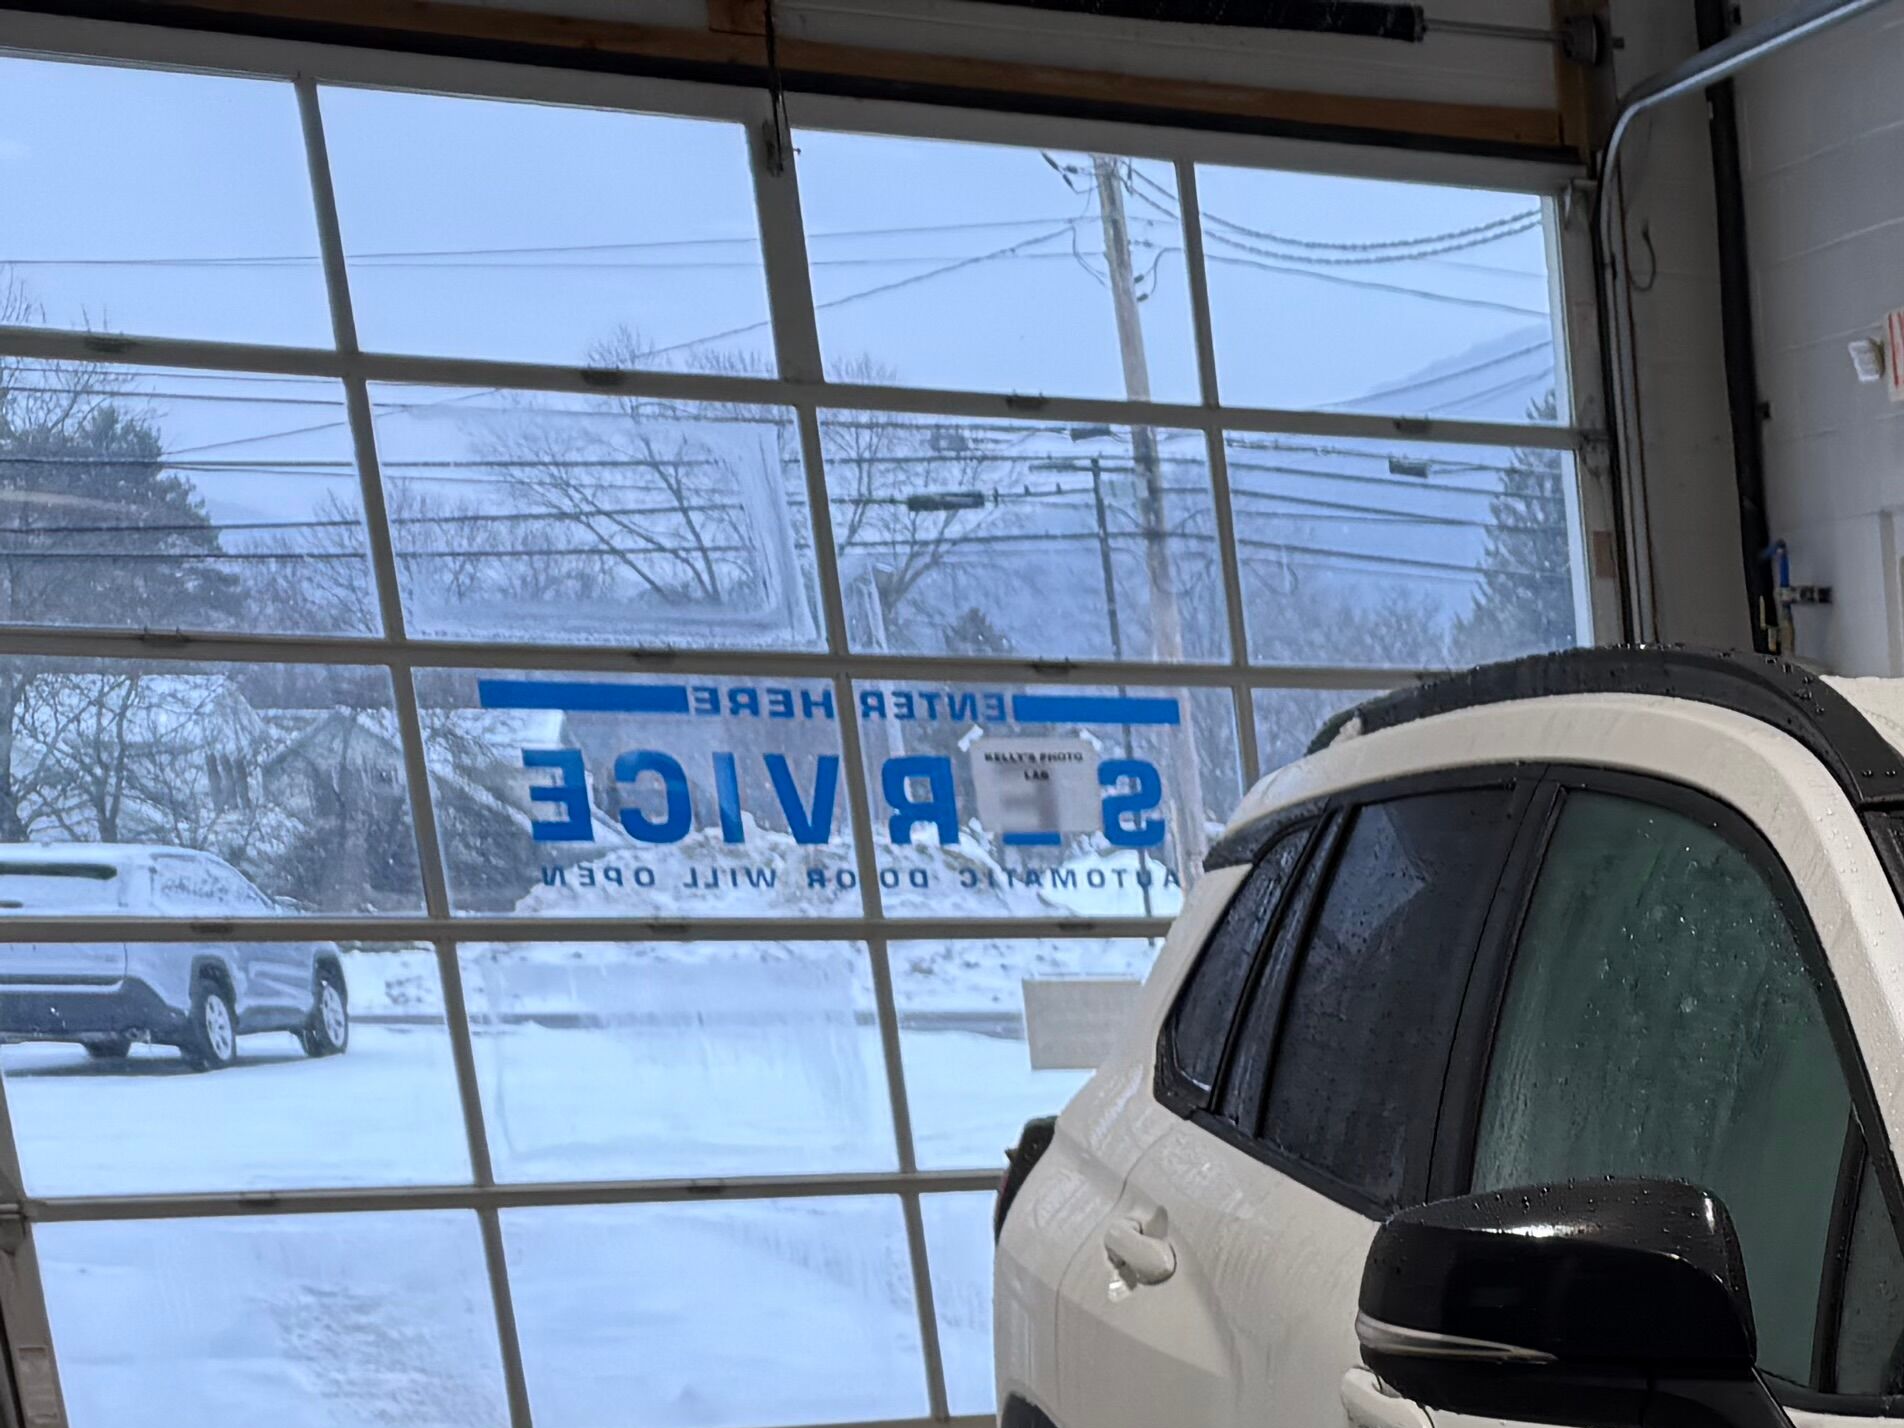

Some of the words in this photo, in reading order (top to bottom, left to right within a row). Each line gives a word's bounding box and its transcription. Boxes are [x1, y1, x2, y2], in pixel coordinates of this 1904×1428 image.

[984, 751, 1036, 763] KELLY'S
[1039, 751, 1083, 762] PHOTO
[1023, 769, 1050, 781] LAB
